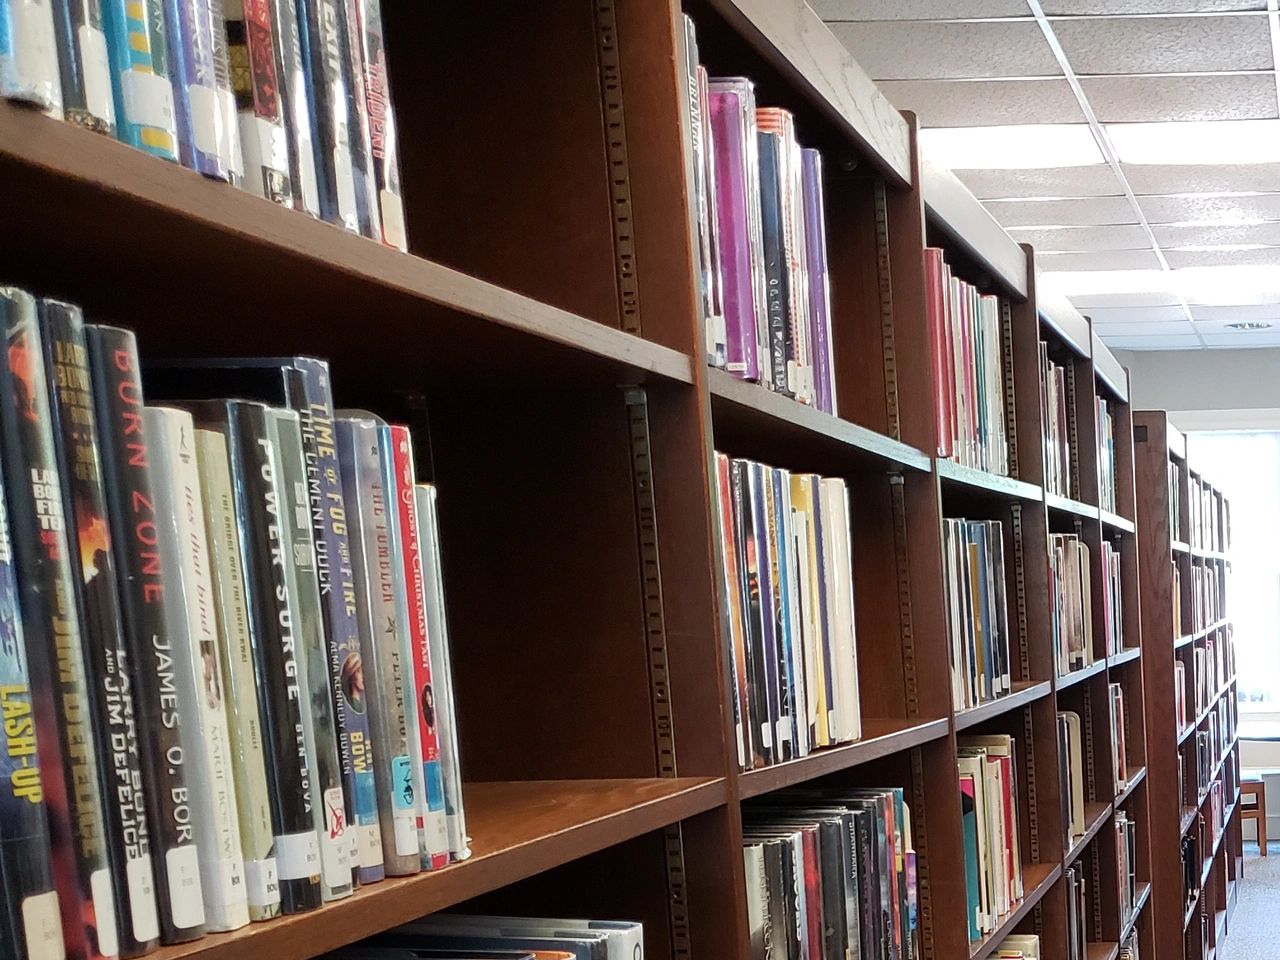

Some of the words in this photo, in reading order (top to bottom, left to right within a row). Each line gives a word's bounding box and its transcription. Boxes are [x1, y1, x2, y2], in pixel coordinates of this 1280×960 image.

[114, 350, 150, 468] BURN
[304, 452, 326, 532] CEMENT
[310, 402, 336, 461] TIME
[326, 491, 349, 536] FOG
[131, 490, 165, 604] ZONE
[257, 437, 284, 567] POWER
[275, 584, 300, 702] SURGE
[314, 538, 334, 596] DUCK
[229, 554, 238, 580] OVER
[240, 636, 248, 663] KWAI
[104, 648, 115, 675] AND
[105, 675, 124, 727] JIM
[152, 634, 181, 730] JAMES
[329, 640, 339, 674] ALMA
[0, 683, 43, 805] LASH-UP
[166, 745, 185, 776] O.
[299, 767, 312, 814] BOVA
[110, 732, 138, 861] DEFELICE
